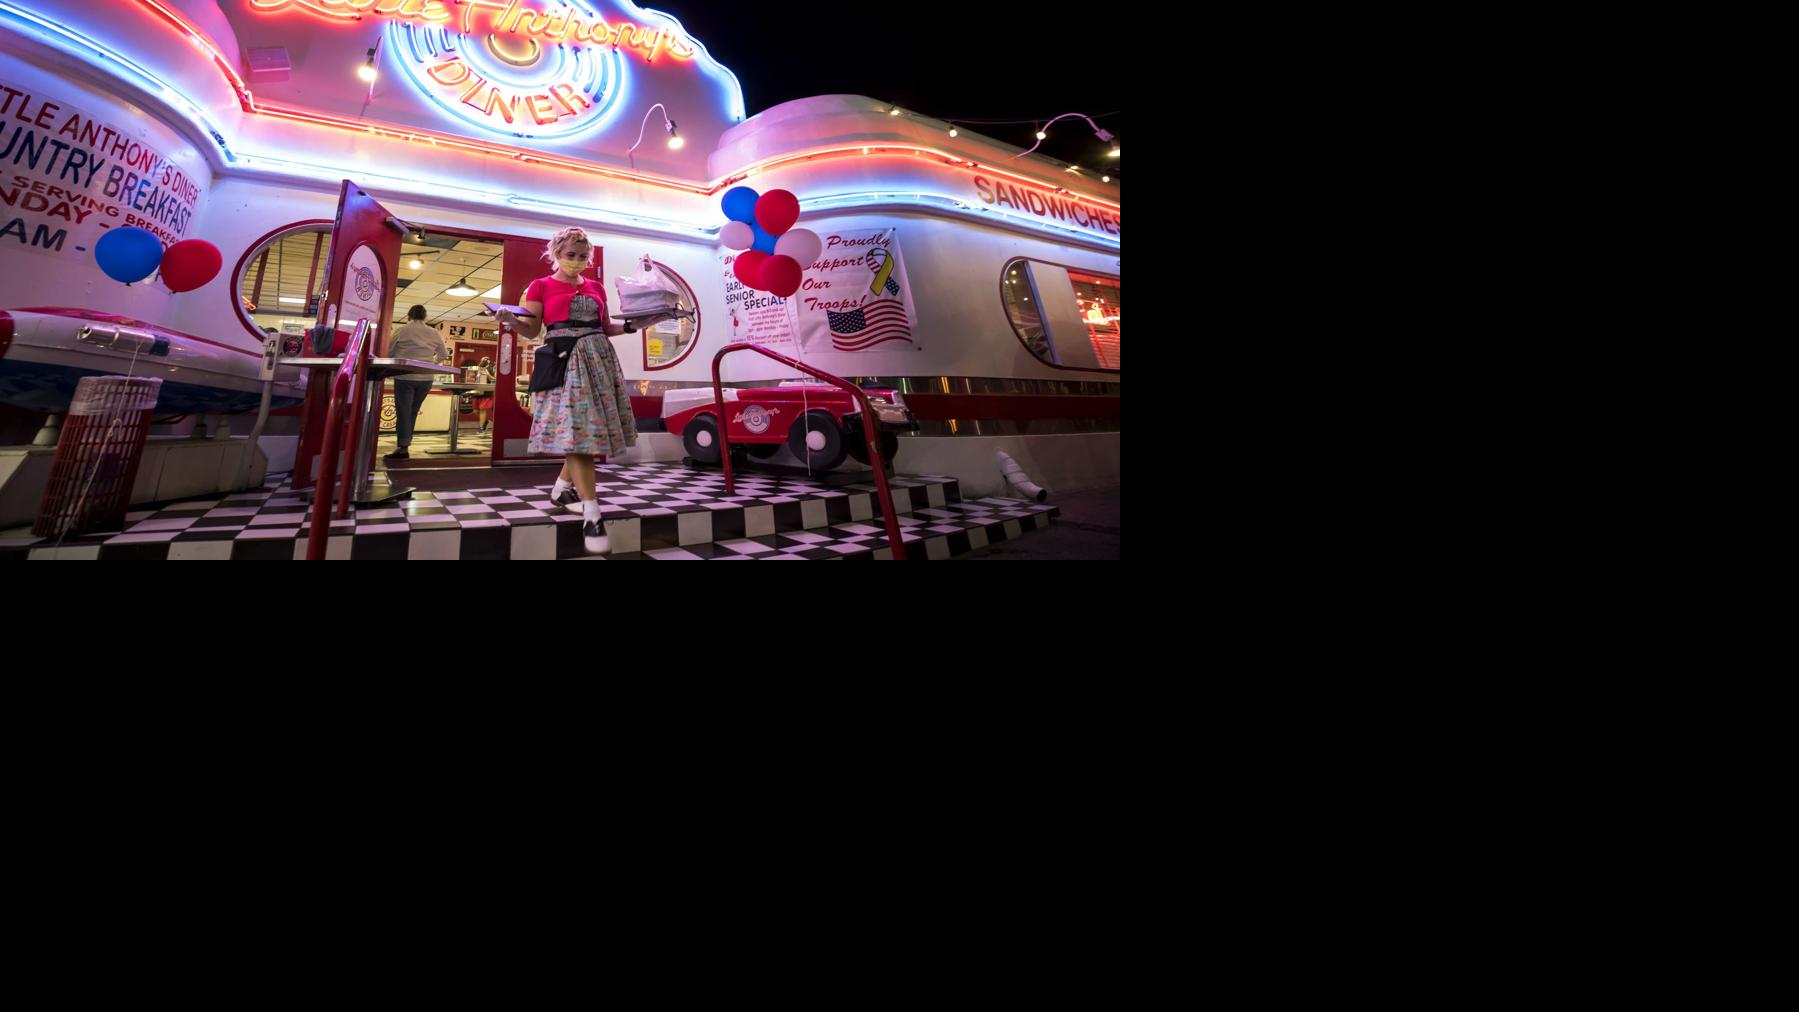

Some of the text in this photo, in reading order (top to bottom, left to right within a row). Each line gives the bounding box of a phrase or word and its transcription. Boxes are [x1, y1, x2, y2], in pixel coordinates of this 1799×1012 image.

[427, 56, 590, 125] DINER
[0, 85, 199, 206] TLE ANTHONY'S DINER
[103, 164, 192, 237] BREAKFAST
[11, 175, 120, 217] SERVING
[125, 213, 180, 243] BREAKFA
[826, 233, 891, 249] Proudly
[802, 256, 865, 272] upport
[802, 278, 831, 291] Our
[726, 290, 755, 305] SENIOR
[804, 295, 867, 311] Troops!
